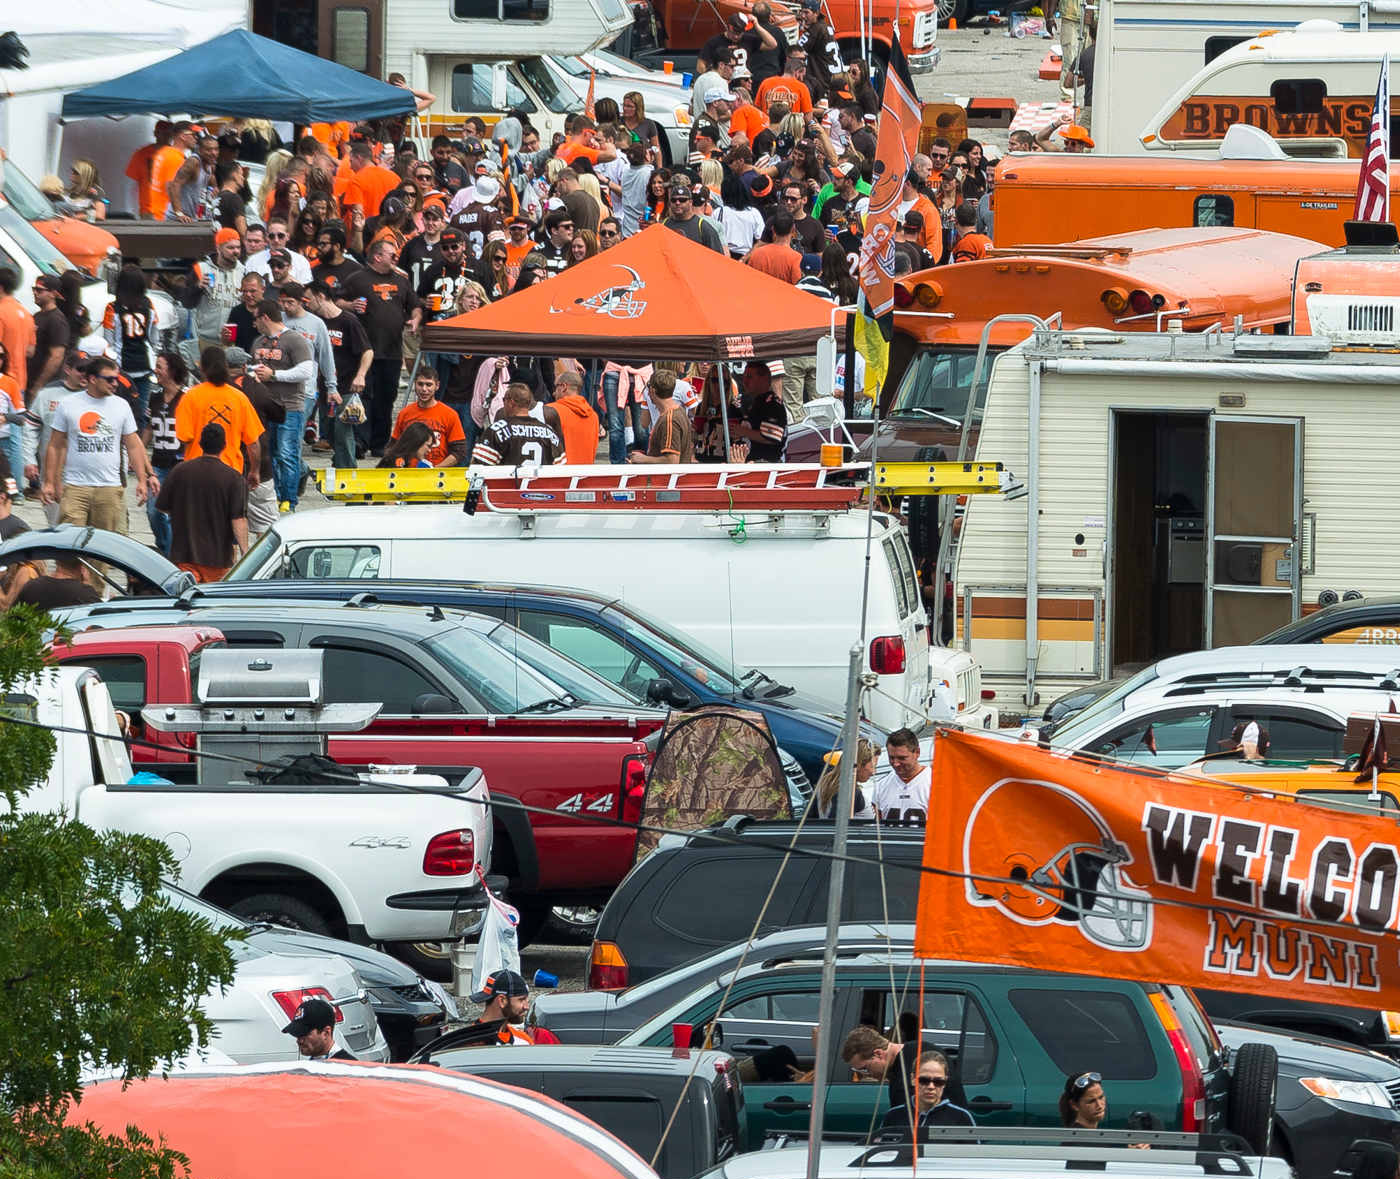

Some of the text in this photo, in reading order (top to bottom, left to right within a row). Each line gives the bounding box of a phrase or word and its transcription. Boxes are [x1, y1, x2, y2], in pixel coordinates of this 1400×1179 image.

[1184, 101, 1374, 139] BROWNS
[78, 441, 114, 453] BROWNS
[1202, 906, 1381, 992] MUNI
